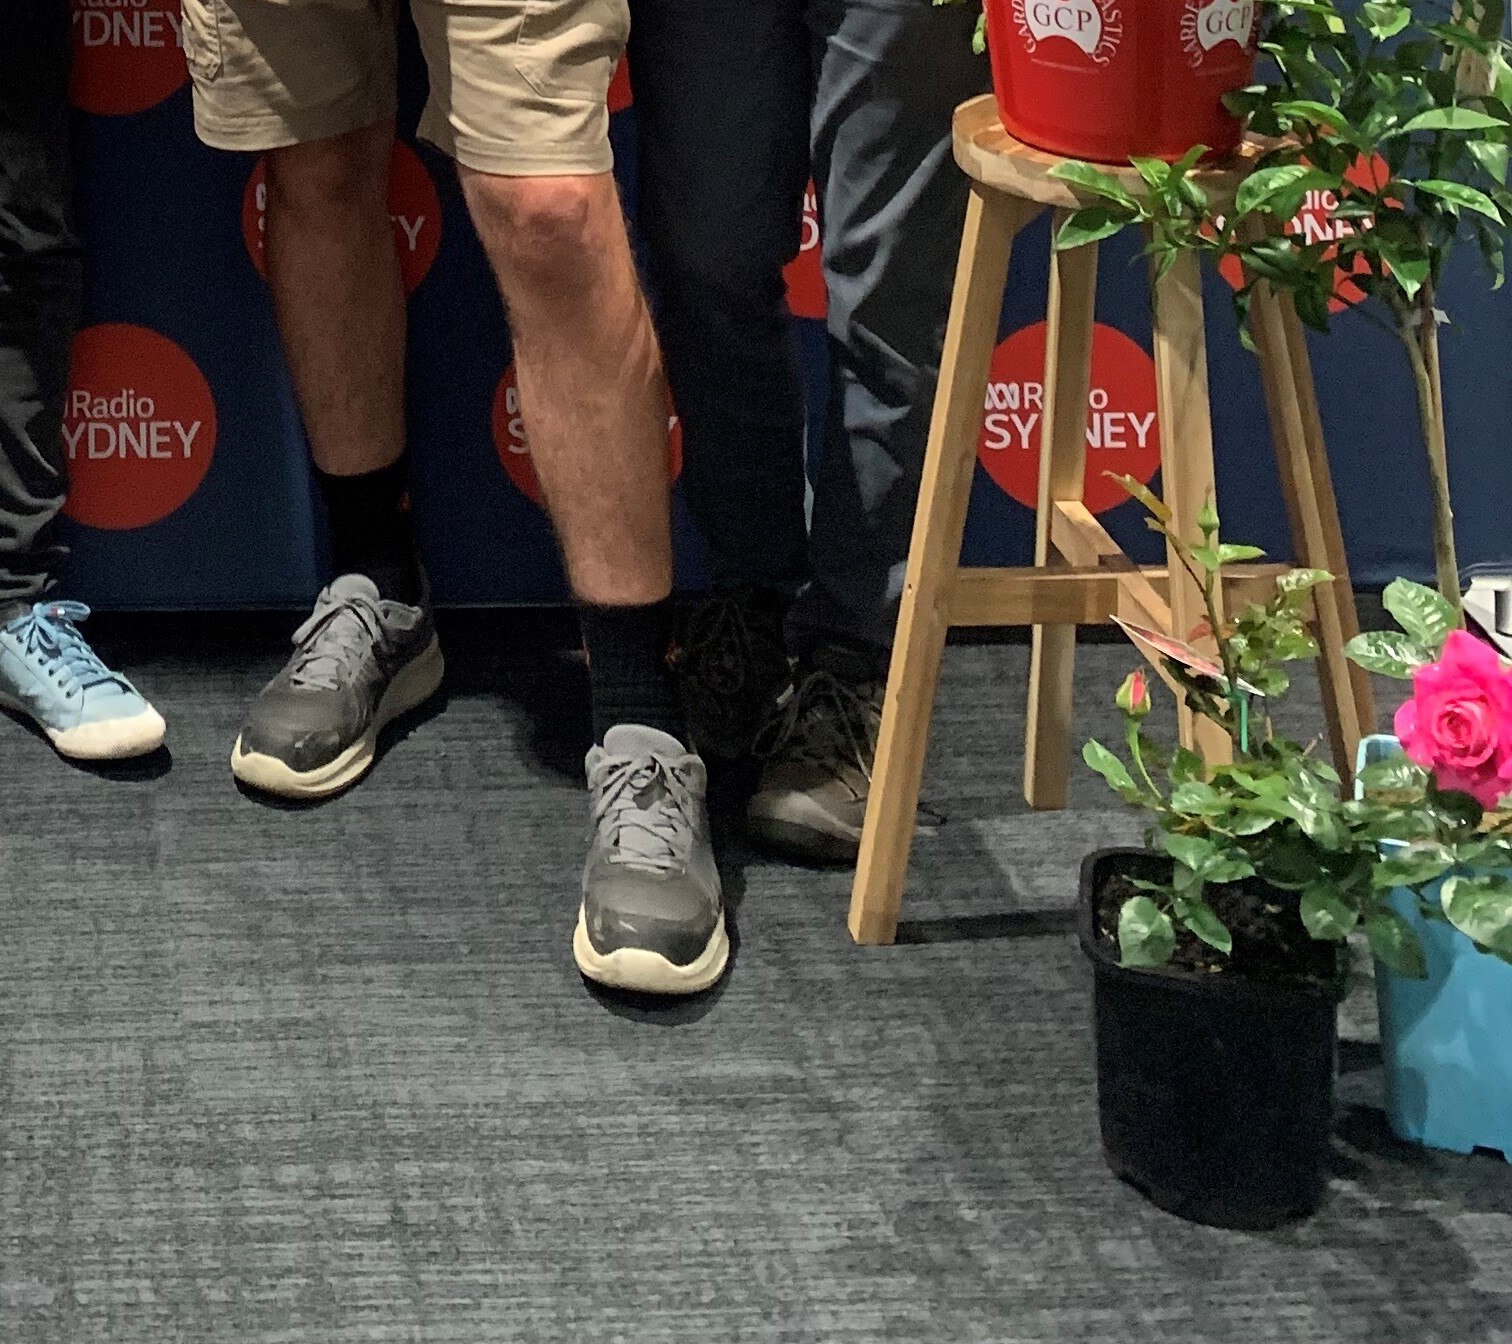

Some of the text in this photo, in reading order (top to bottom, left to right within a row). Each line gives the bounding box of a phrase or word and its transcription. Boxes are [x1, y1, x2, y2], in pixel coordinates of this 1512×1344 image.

[1033, 2, 1092, 33] GCP
[1205, 4, 1251, 36] GCP
[72, 389, 155, 418] Radio
[61, 420, 201, 459] YDNEY
